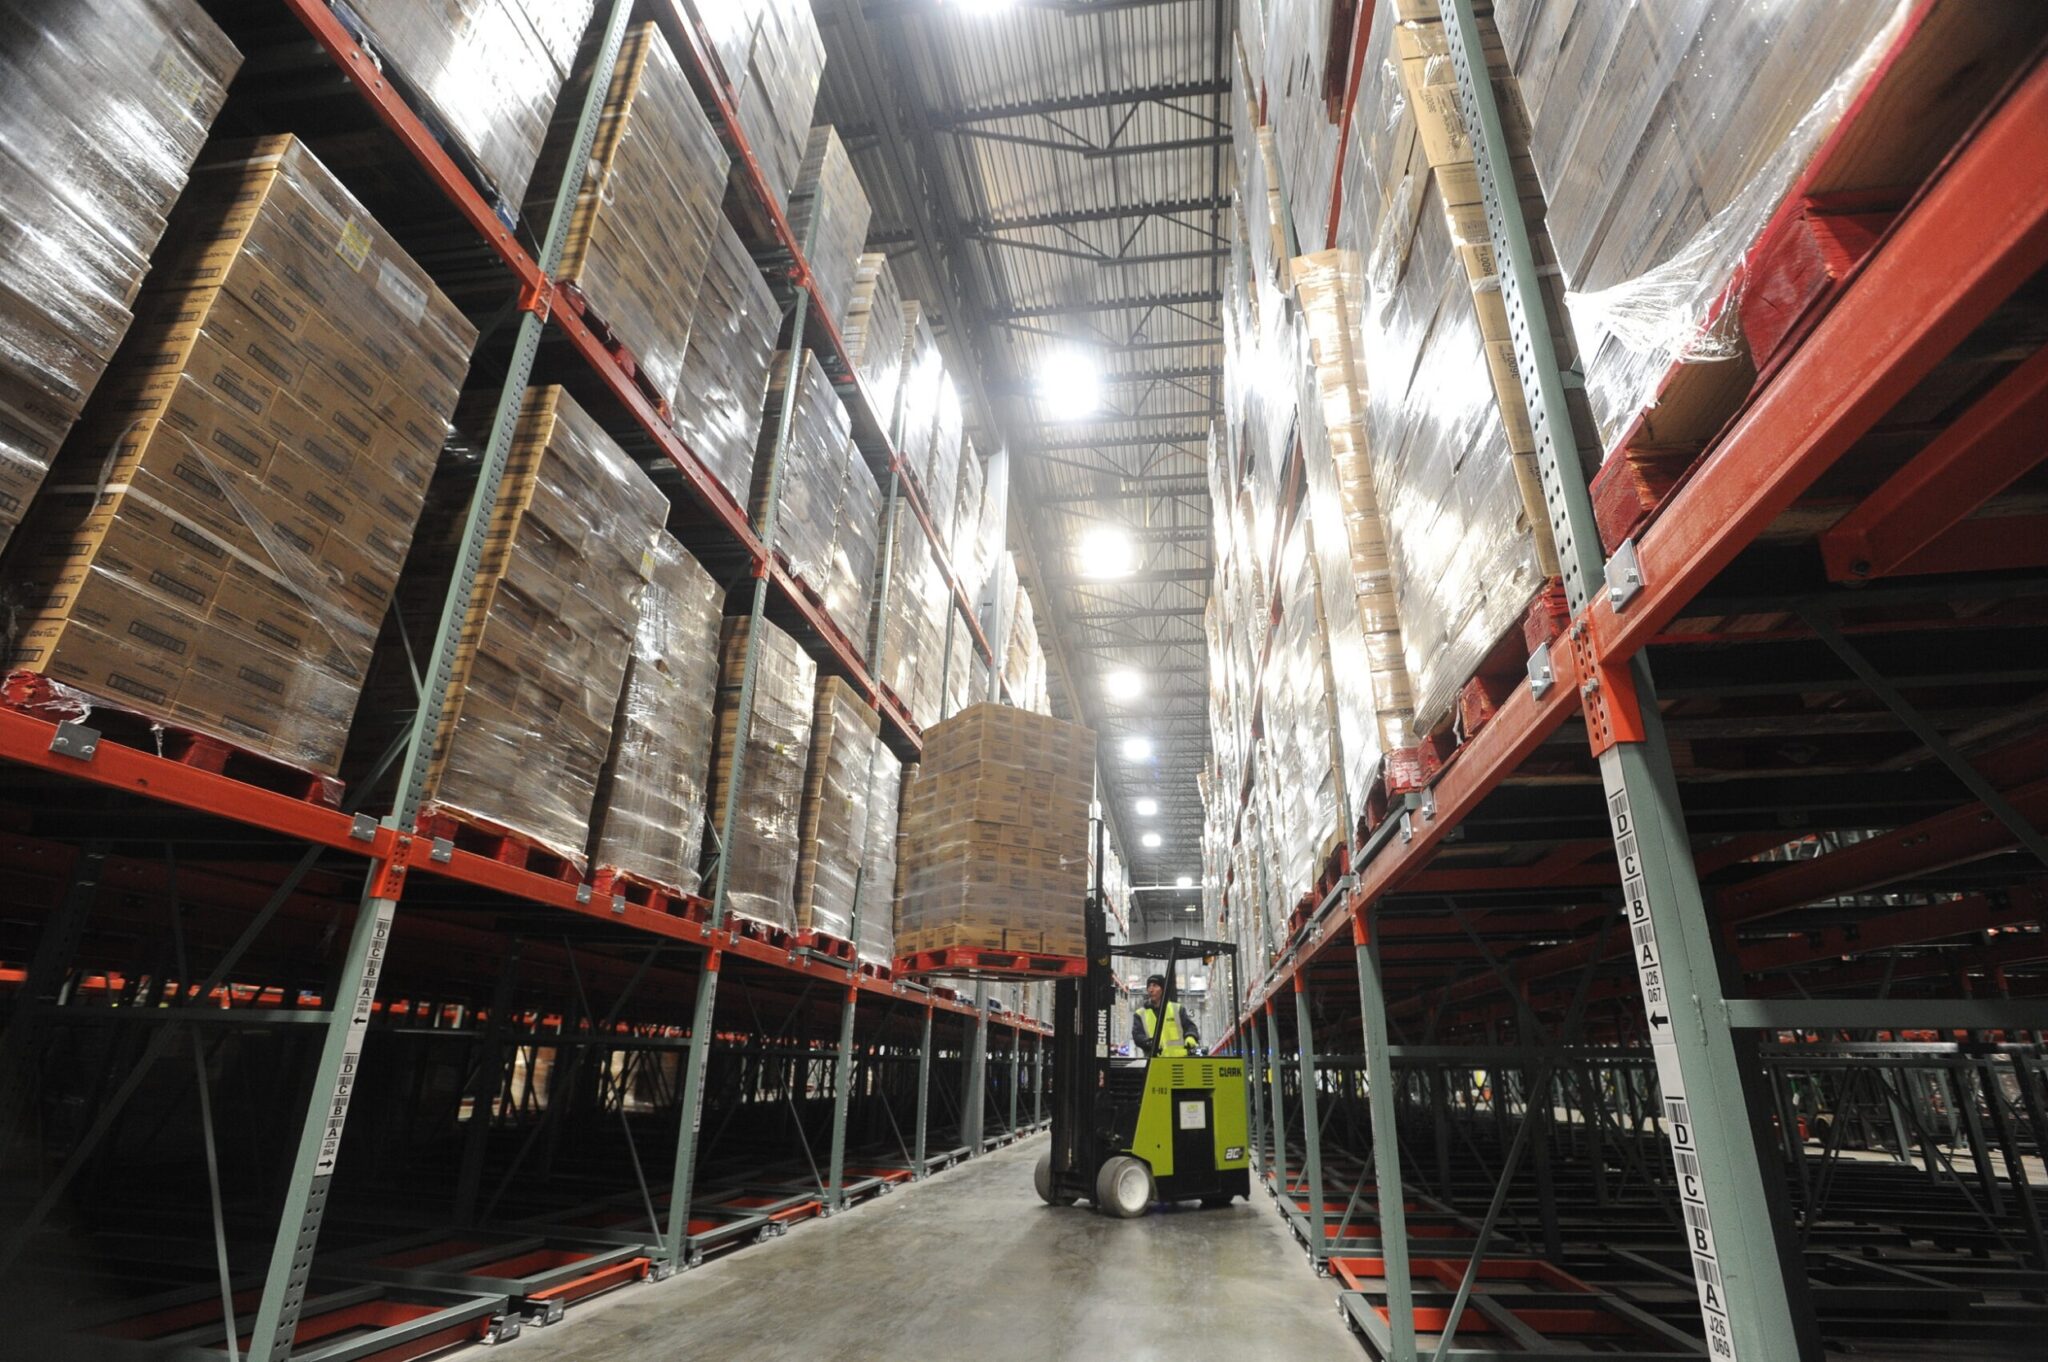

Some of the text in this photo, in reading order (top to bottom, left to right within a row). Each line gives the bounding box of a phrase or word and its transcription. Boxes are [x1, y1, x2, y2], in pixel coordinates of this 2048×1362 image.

[1506, 352, 1520, 380] 36001
[1616, 813, 1629, 832] D
[1625, 856, 1636, 875] C
[1633, 899, 1644, 918] B
[376, 929, 385, 938] D
[372, 948, 380, 958] C
[1642, 944, 1654, 963] A
[367, 967, 375, 977] B
[1645, 970, 1659, 986] J26
[362, 988, 370, 997] A
[1648, 987, 1662, 1003] 067
[1097, 1009, 1107, 1045] CLARK
[343, 1064, 352, 1073] D
[1219, 1066, 1242, 1077] CLARK
[338, 1085, 347, 1095] C
[334, 1106, 342, 1115] B
[328, 1127, 337, 1137] A
[1675, 1124, 1688, 1145] D
[1684, 1174, 1697, 1197] C
[1694, 1227, 1707, 1251] B
[1705, 1283, 1719, 1309] A
[1709, 1315, 1726, 1337] J26
[1712, 1336, 1731, 1359] 069
